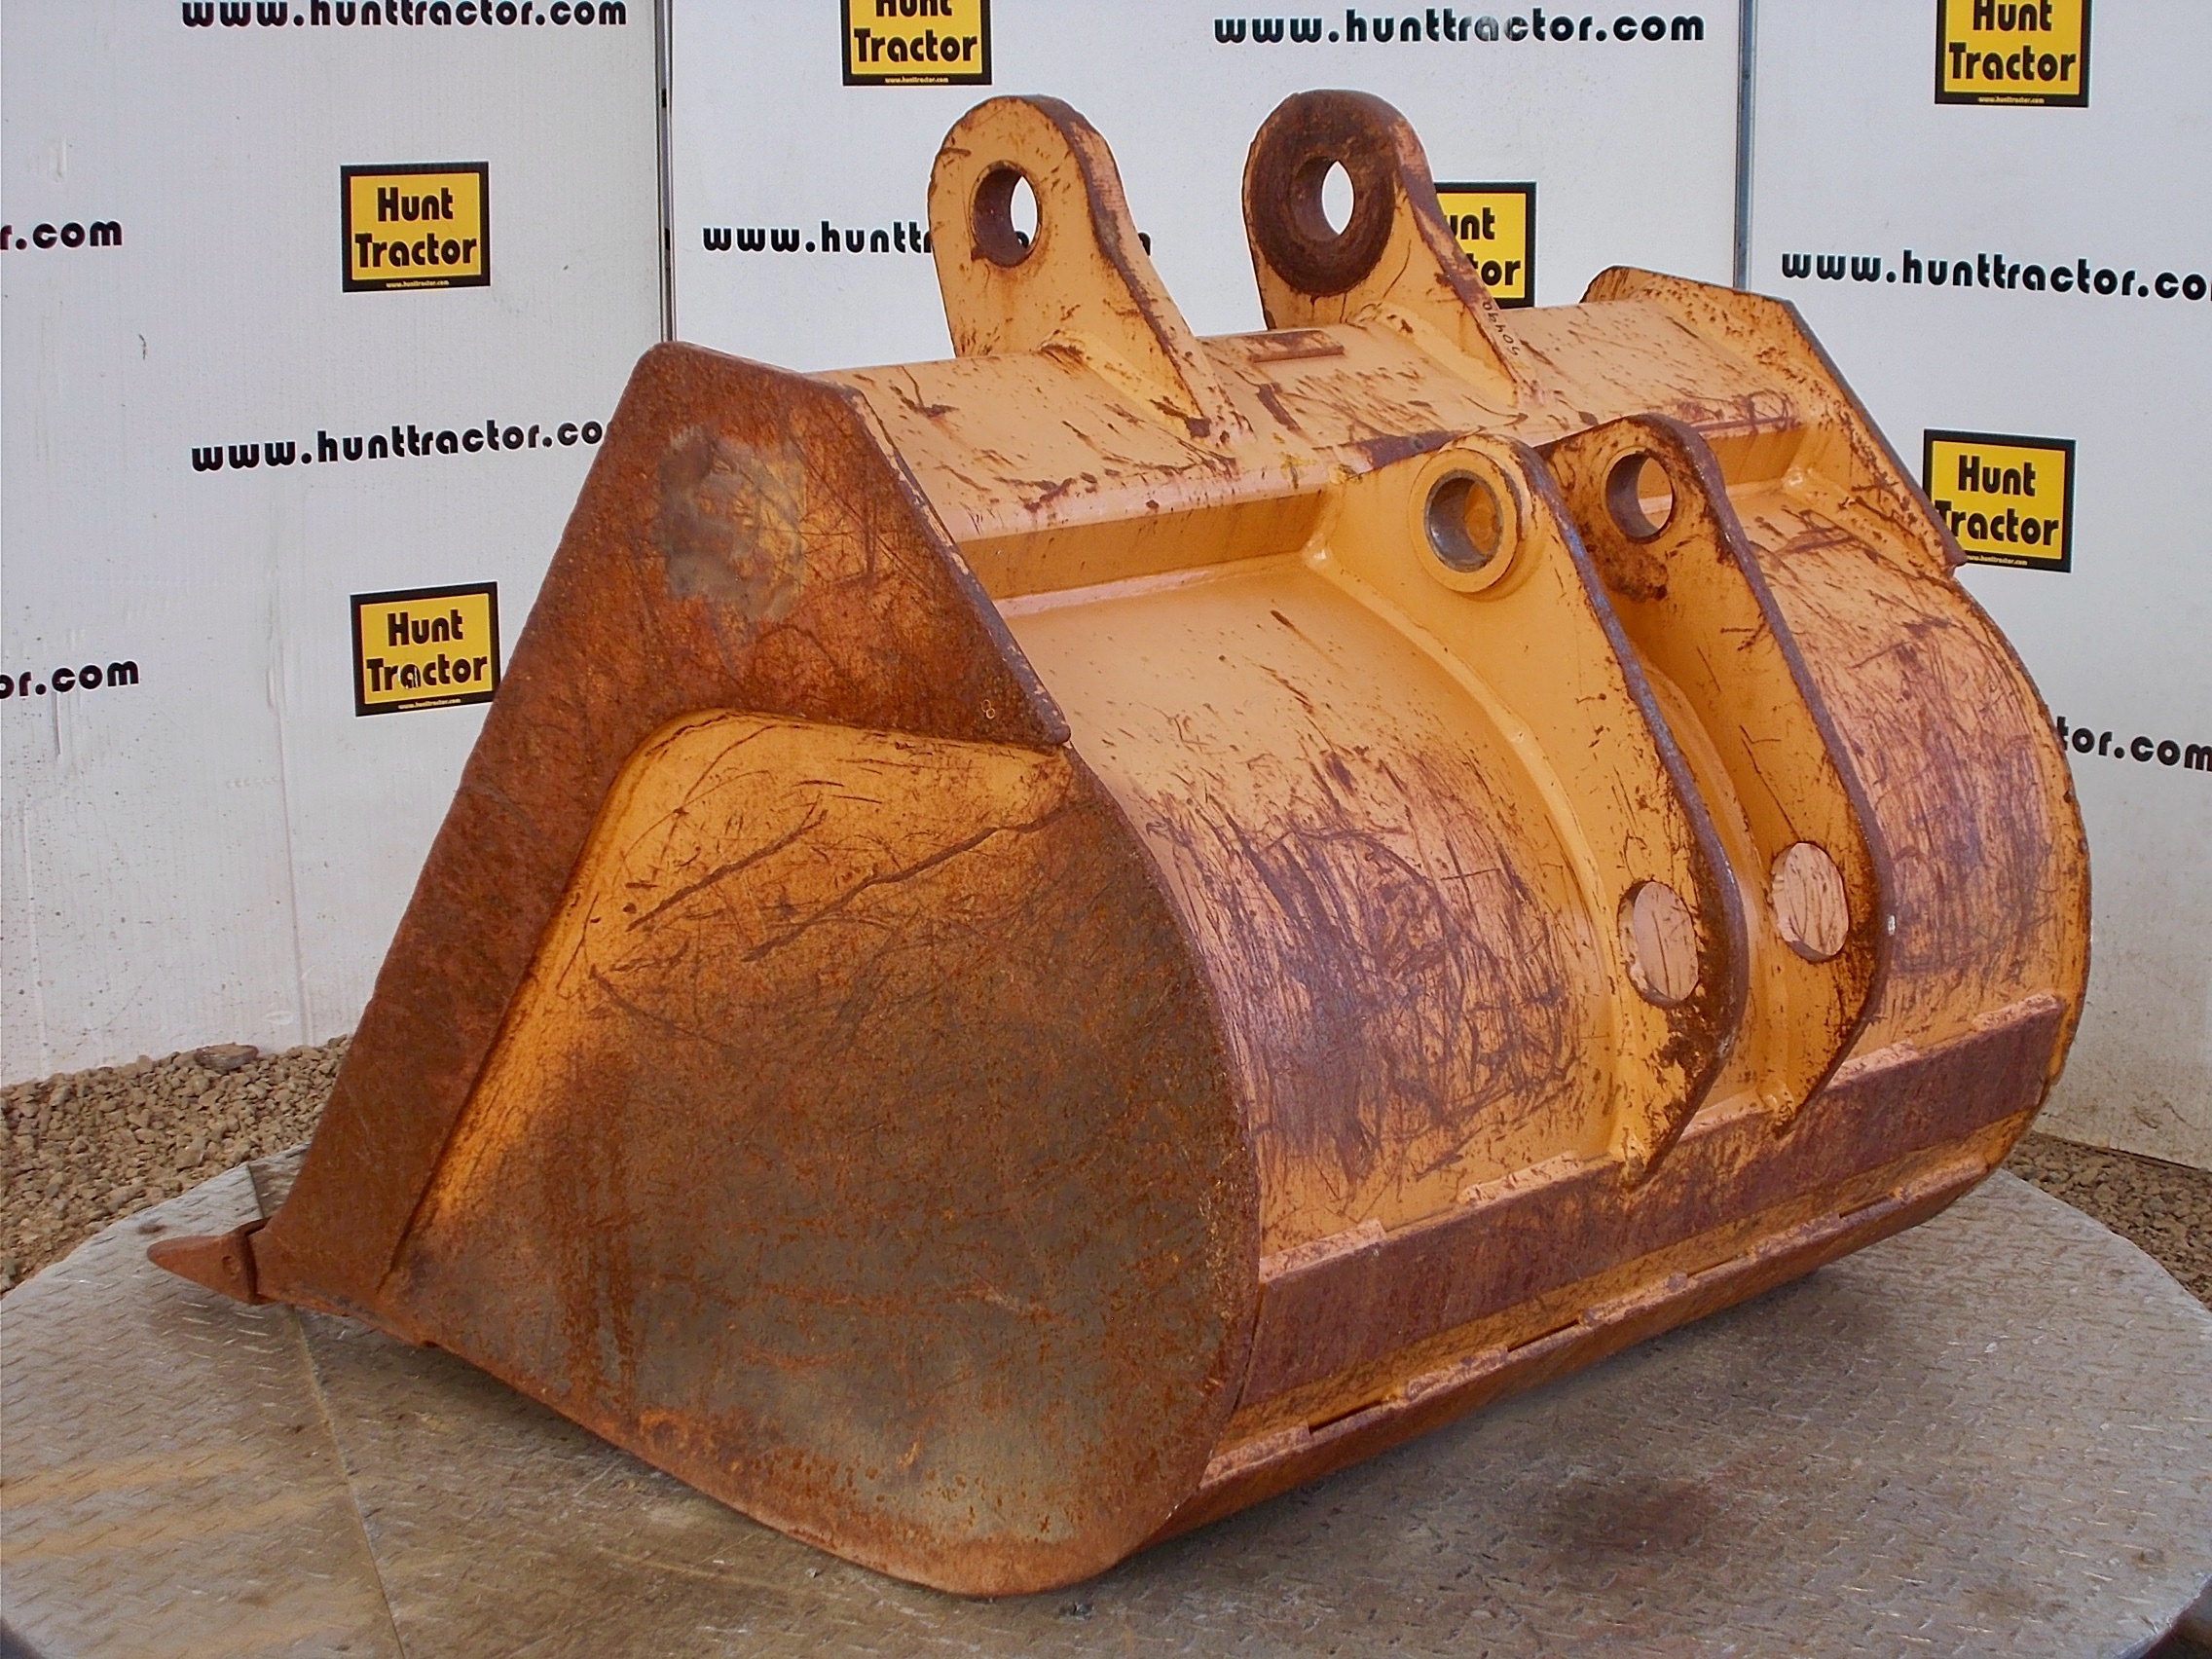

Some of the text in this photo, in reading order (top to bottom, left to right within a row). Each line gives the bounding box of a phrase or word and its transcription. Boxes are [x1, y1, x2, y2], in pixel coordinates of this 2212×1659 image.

[183, 0, 626, 27] www.hunttractor.com
[1215, 9, 1704, 44] www.hunttractor.com
[1973, 0, 2052, 31] Hunt
[854, 28, 977, 62] Tractor
[1949, 42, 2076, 81] Tractor
[378, 187, 453, 222] Hunt
[355, 233, 477, 268] Tractor
[1782, 250, 2212, 302] www.hunttractor.co
[1959, 455, 2036, 497] Hunt
[1935, 500, 2059, 546] Tractor
[387, 609, 463, 646] Hunt
[366, 654, 487, 692] Tractor
